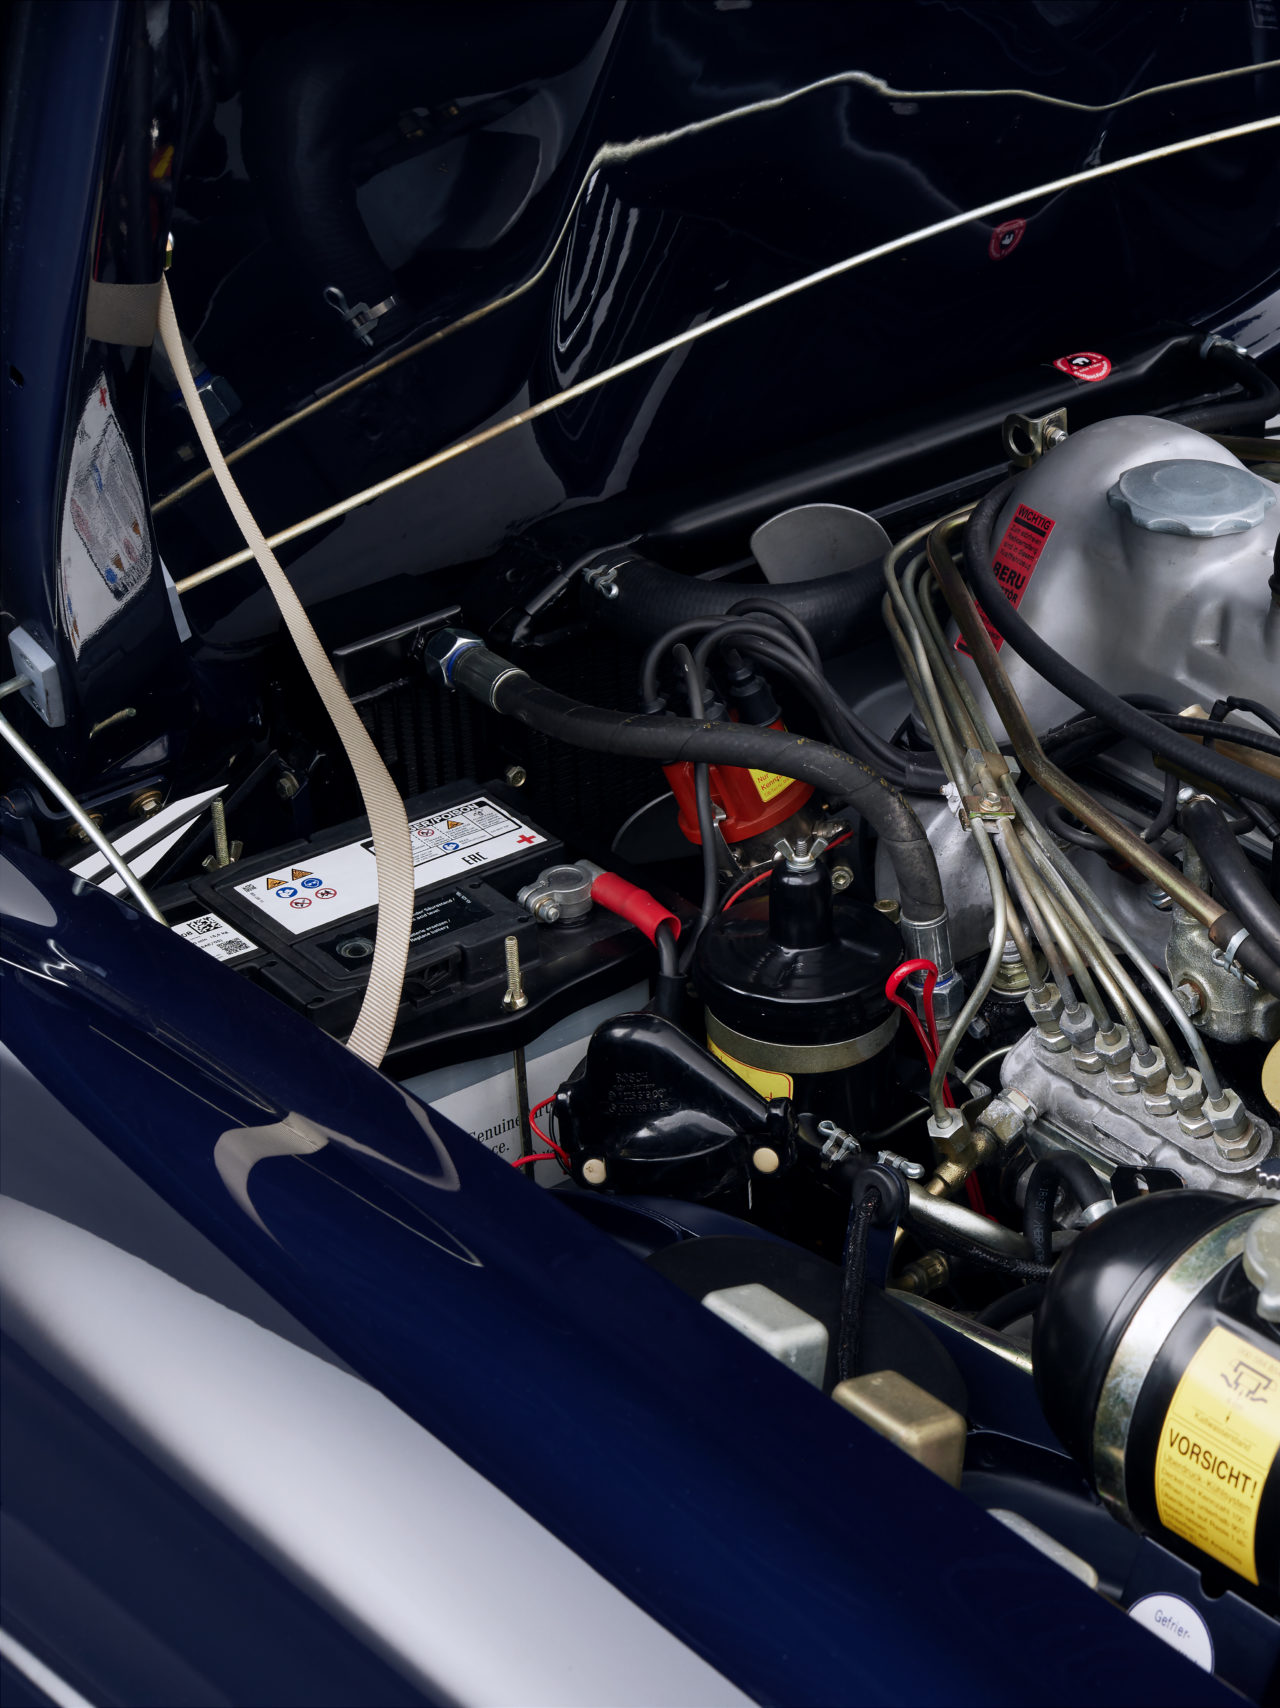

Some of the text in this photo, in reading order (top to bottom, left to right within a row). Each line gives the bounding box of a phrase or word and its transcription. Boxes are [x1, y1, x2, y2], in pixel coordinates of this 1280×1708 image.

[1018, 505, 1051, 530] WICHTIG
[993, 561, 1026, 589] BERU
[468, 1117, 520, 1143] enuine
[1169, 1428, 1257, 1499] VORSICHT!
[1154, 1609, 1191, 1639] Gefrier-
